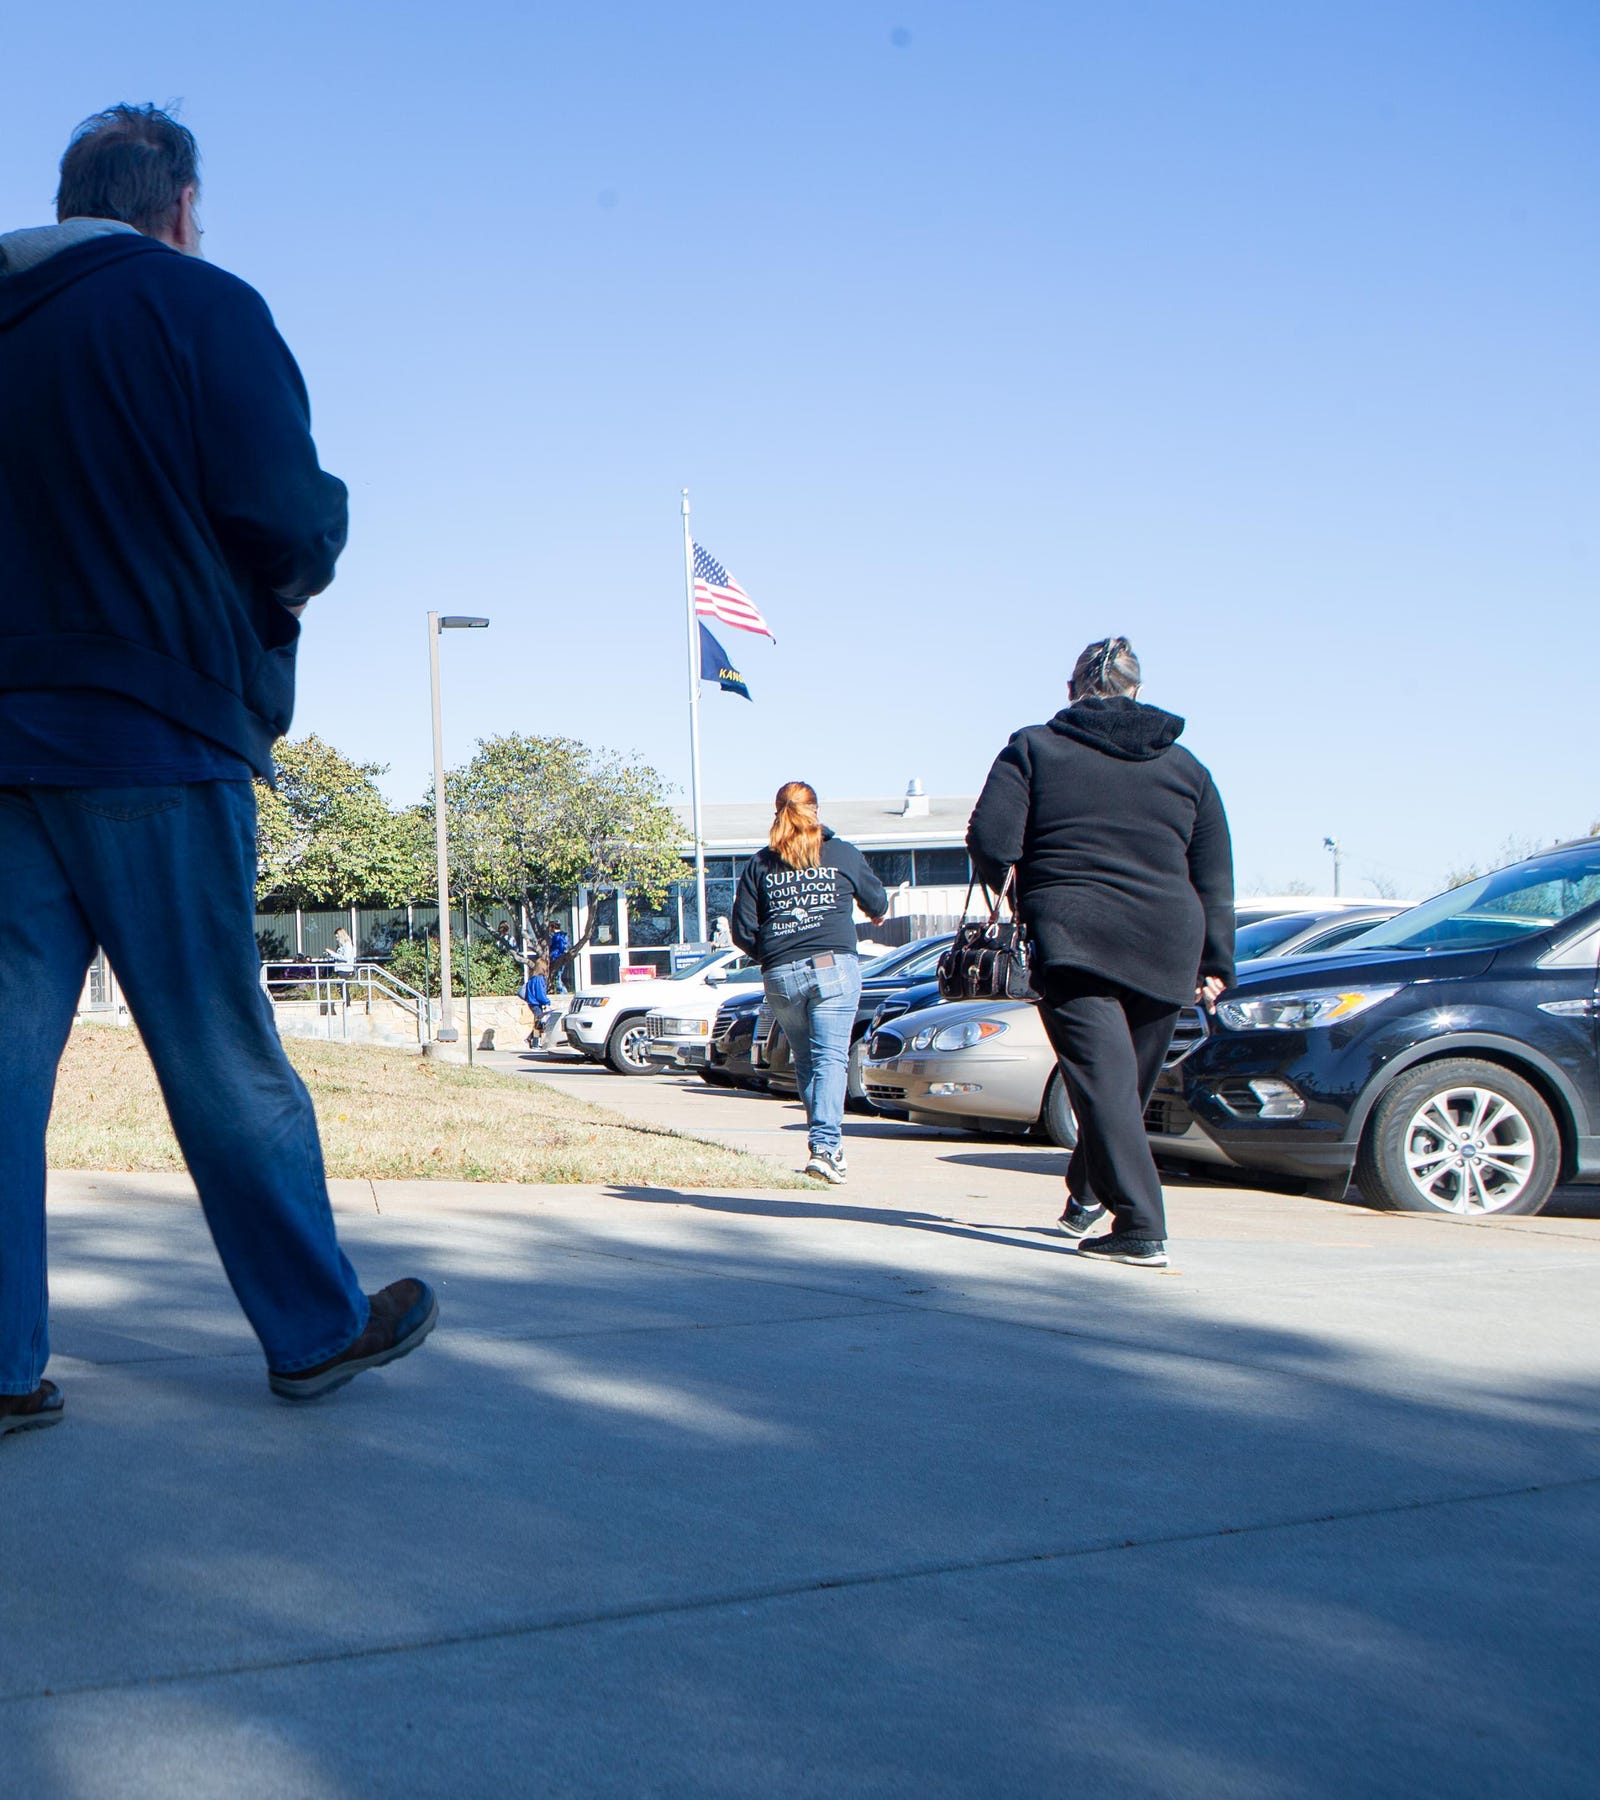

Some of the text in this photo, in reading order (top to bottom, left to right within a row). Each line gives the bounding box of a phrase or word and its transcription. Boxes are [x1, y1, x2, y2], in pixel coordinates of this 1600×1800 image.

[765, 867, 838, 888] SUPPORT
[767, 882, 837, 899] YOUR LOCAL
[772, 921, 797, 930] BLIND
[629, 968, 647, 976] VOTE
